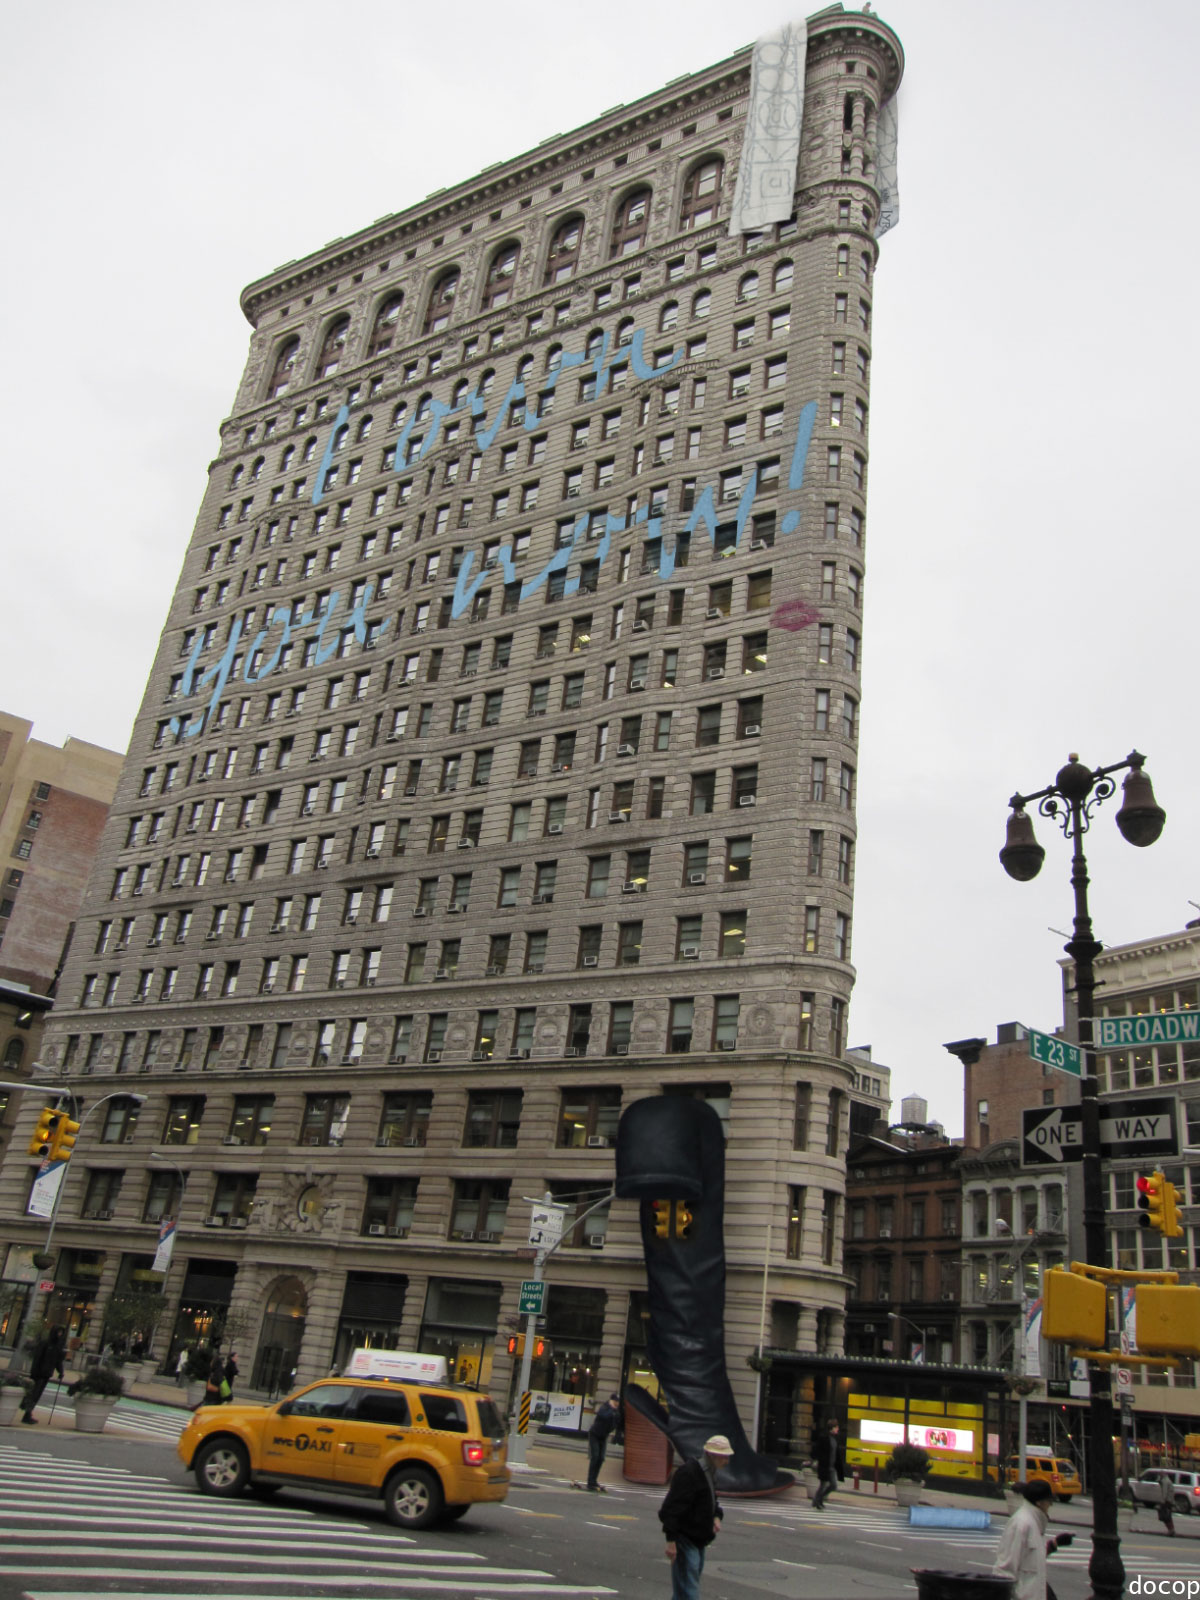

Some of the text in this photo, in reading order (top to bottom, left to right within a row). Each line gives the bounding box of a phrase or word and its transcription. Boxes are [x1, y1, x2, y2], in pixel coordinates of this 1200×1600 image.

[170, 584, 392, 737] you
[1102, 1015, 1200, 1043] BROADW
[1033, 1034, 1078, 1067] E 23 ST
[1036, 1117, 1160, 1145] ONE WAY
[521, 1292, 542, 1300] Streets
[524, 1283, 541, 1291] Local
[295, 1433, 332, 1453] TAXI
